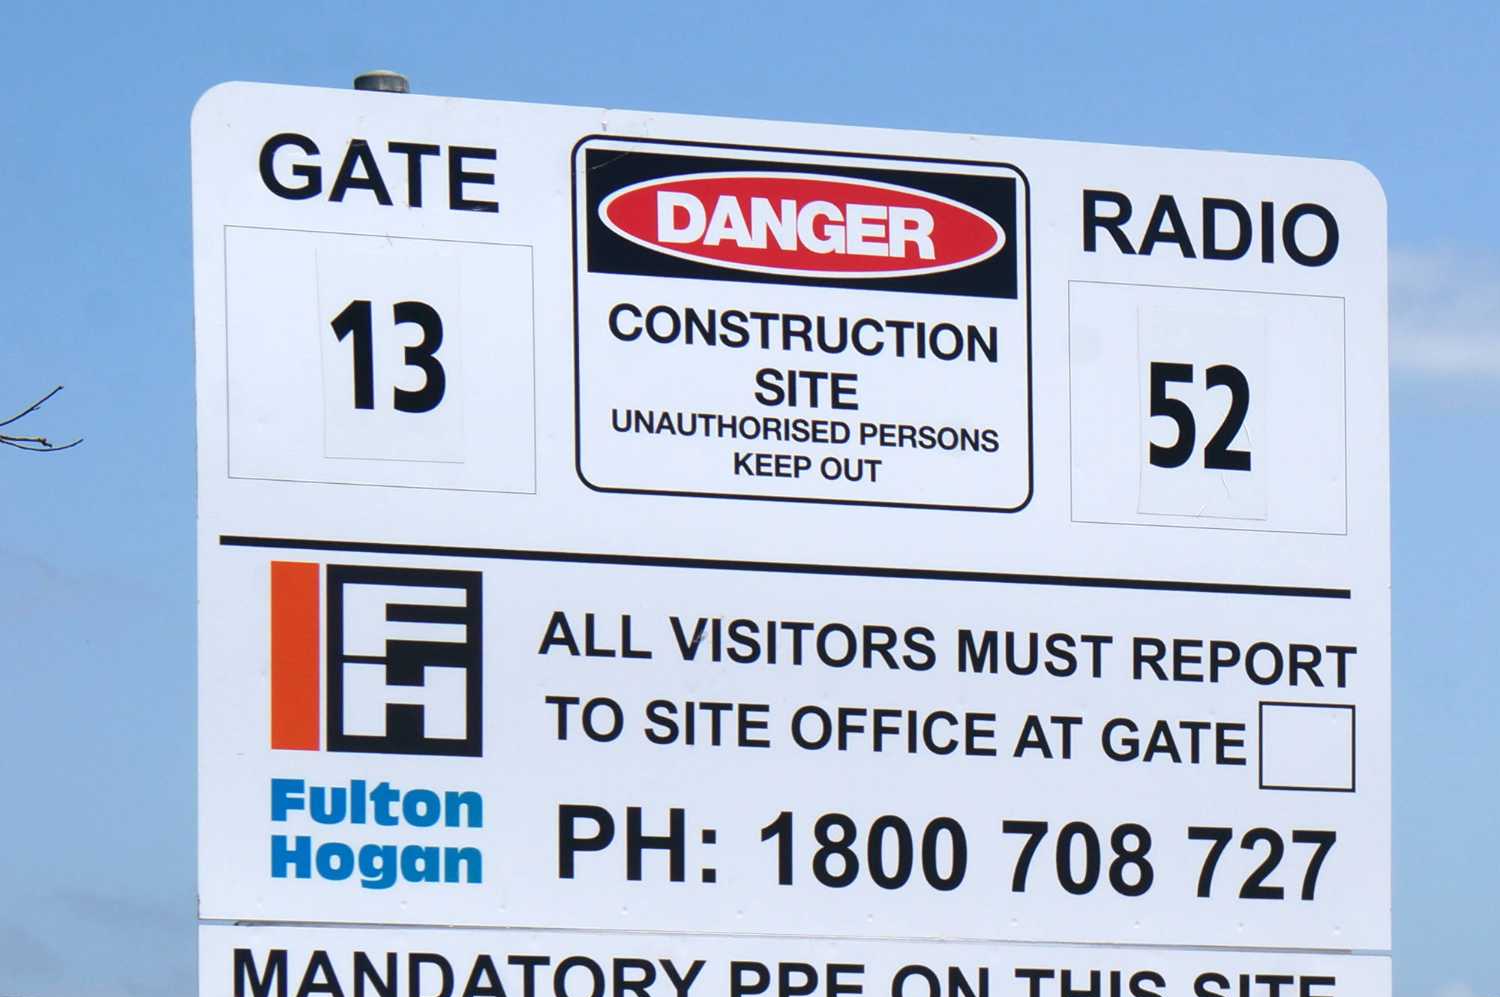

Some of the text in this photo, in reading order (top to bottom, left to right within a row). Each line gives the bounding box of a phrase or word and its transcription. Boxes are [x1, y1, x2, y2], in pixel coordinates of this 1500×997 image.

[258, 132, 500, 214] GATE
[655, 190, 936, 260] DANGER
[1082, 189, 1340, 268] RADIO
[330, 299, 446, 414] 13
[608, 302, 998, 363] CONSTRUCTION
[754, 367, 859, 411] SITE
[1149, 361, 1252, 472] 52
[612, 408, 1000, 453] UNAUTHORISED PERSONS
[733, 451, 883, 483] KEEP OUT
[538, 611, 1358, 689] ALL VISITORS MUST REPORT
[544, 695, 1247, 766] TO SITE OFFICE AT GATE
[271, 778, 483, 829] Fulton
[271, 834, 483, 890] Hogan
[558, 804, 1337, 901] PH: 1800 708 727
